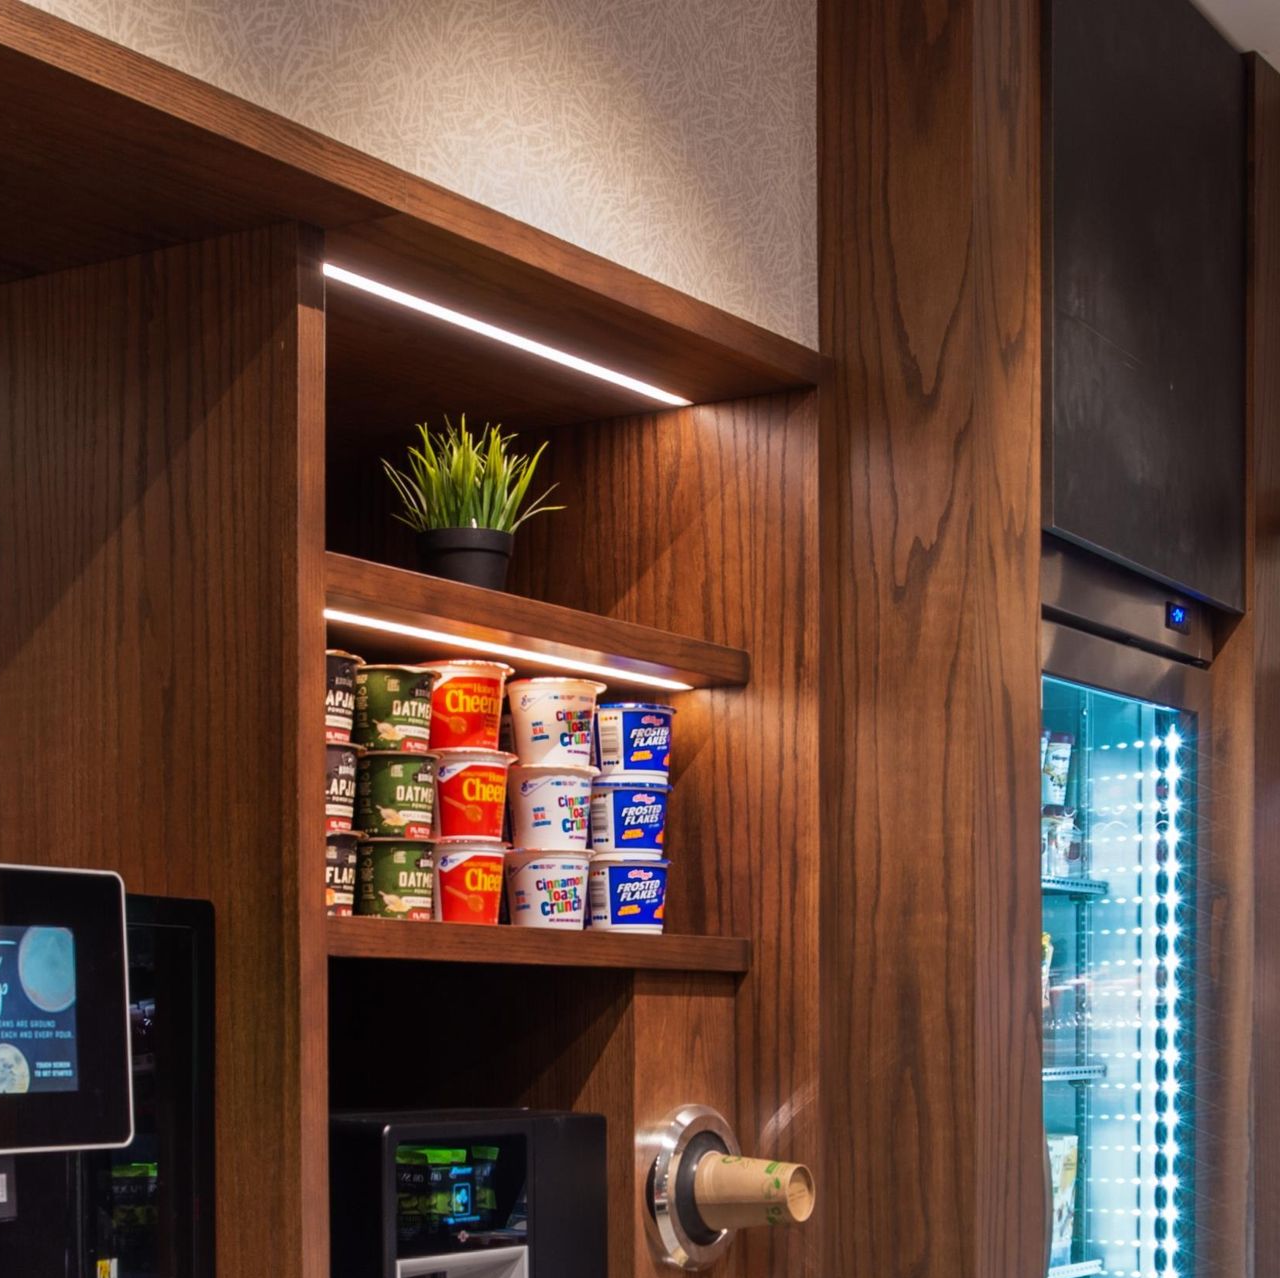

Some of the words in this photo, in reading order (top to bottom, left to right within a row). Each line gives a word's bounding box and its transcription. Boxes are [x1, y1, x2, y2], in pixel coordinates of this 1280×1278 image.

[630, 727, 668, 739] FROSTED
[633, 736, 667, 748] FLAKES
[621, 804, 661, 817] FROSTED
[624, 814, 658, 826] FLAKES
[617, 880, 660, 893] FROSTED
[620, 890, 657, 902] FLAKES
